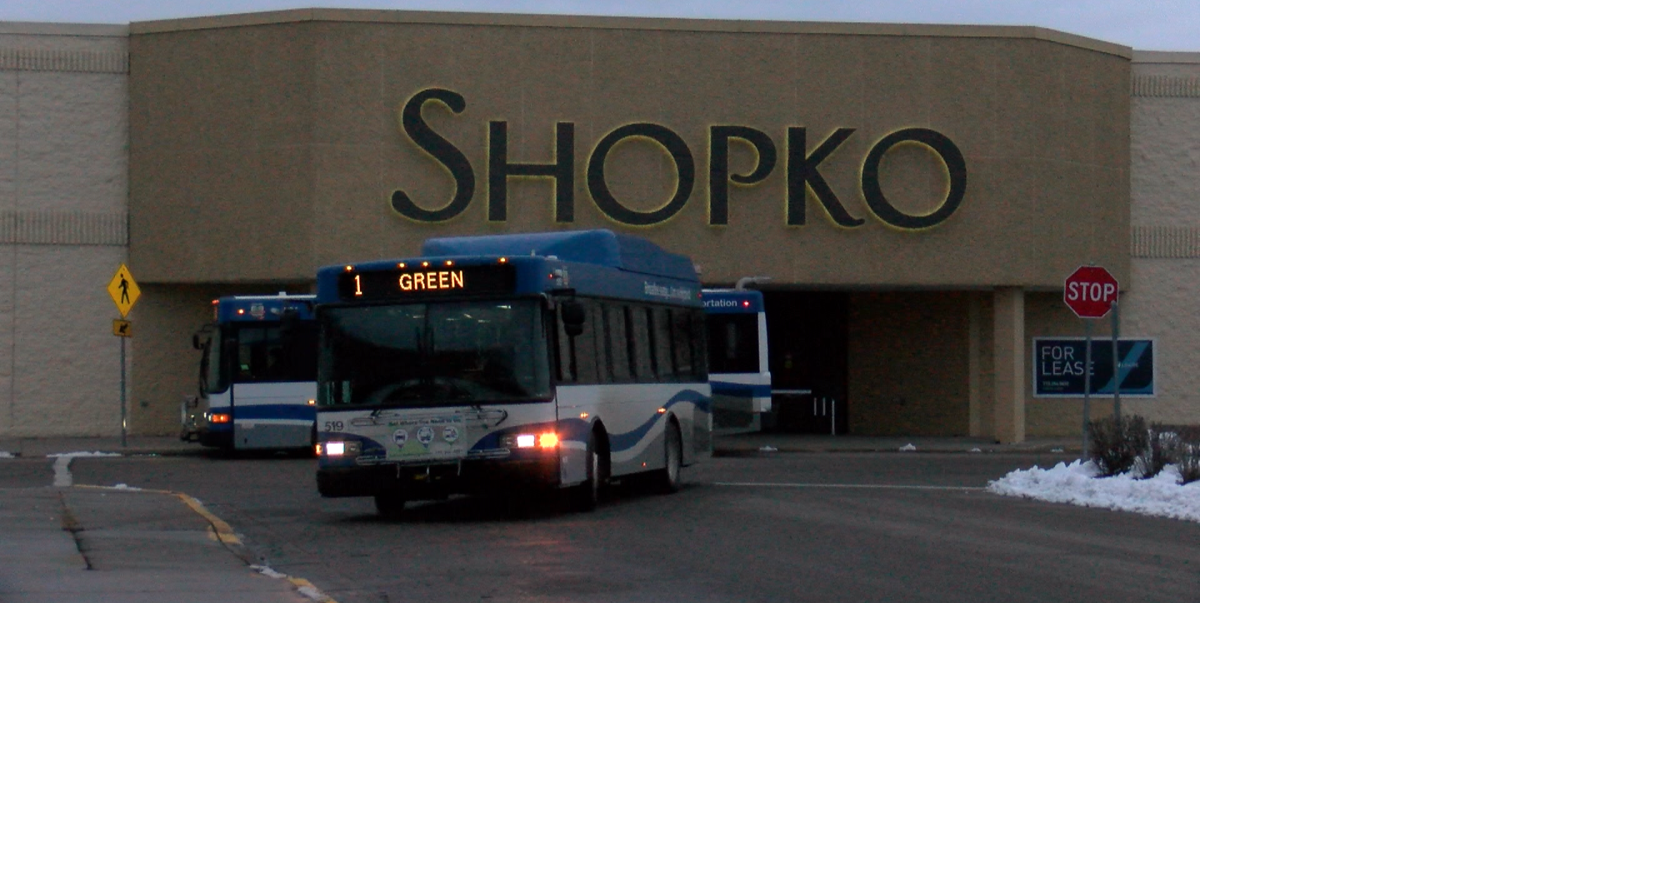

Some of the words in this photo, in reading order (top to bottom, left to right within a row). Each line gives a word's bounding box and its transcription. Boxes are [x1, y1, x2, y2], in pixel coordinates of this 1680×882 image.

[391, 87, 967, 230] SHOPKO
[353, 274, 363, 296] 1
[399, 270, 465, 291] GREEN
[1067, 281, 1115, 302] STOP
[1041, 346, 1075, 360] FOR
[325, 420, 344, 432] 519
